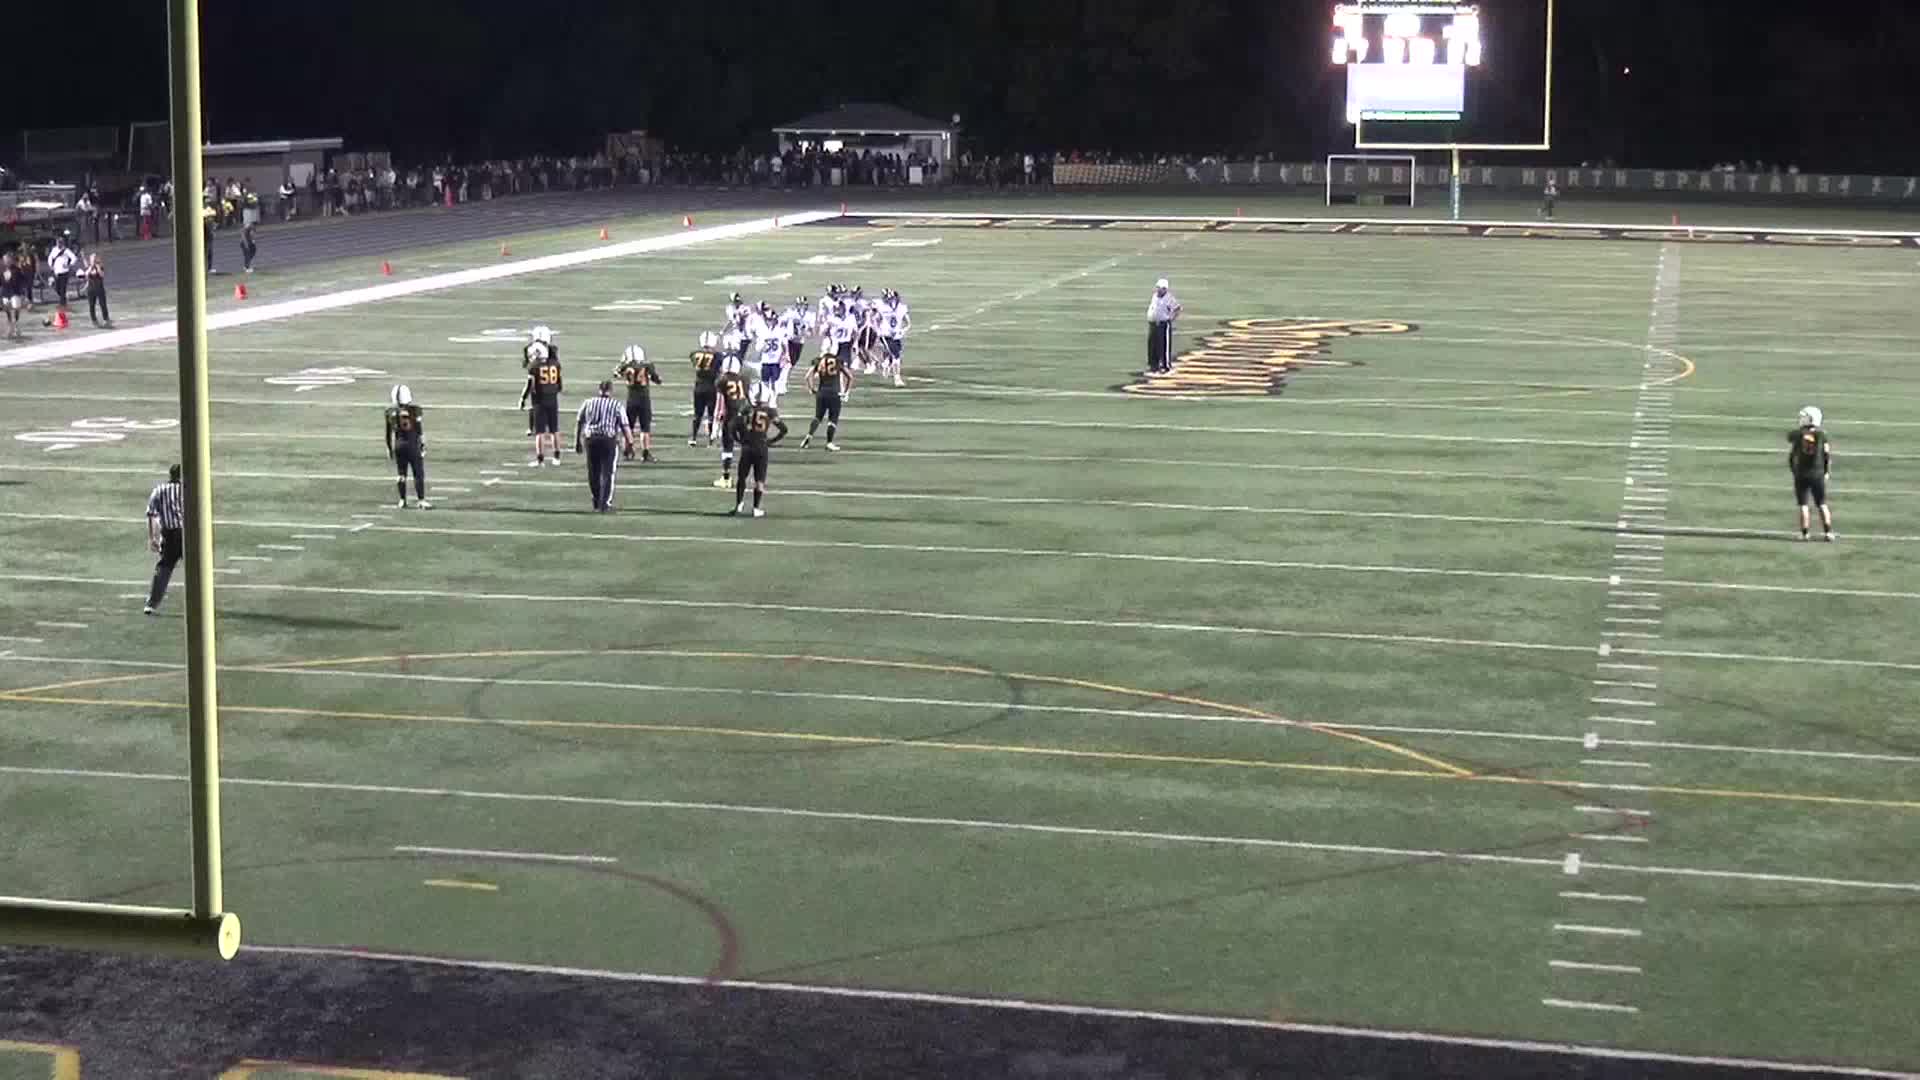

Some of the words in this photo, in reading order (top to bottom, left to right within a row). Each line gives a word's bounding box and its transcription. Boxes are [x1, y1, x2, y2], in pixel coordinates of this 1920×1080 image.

[1302, 165, 1494, 185] GENBROOK
[1651, 171, 1829, 193] SPARTANS
[695, 352, 714, 370] 77
[539, 365, 558, 385] 58
[727, 380, 746, 400] 21
